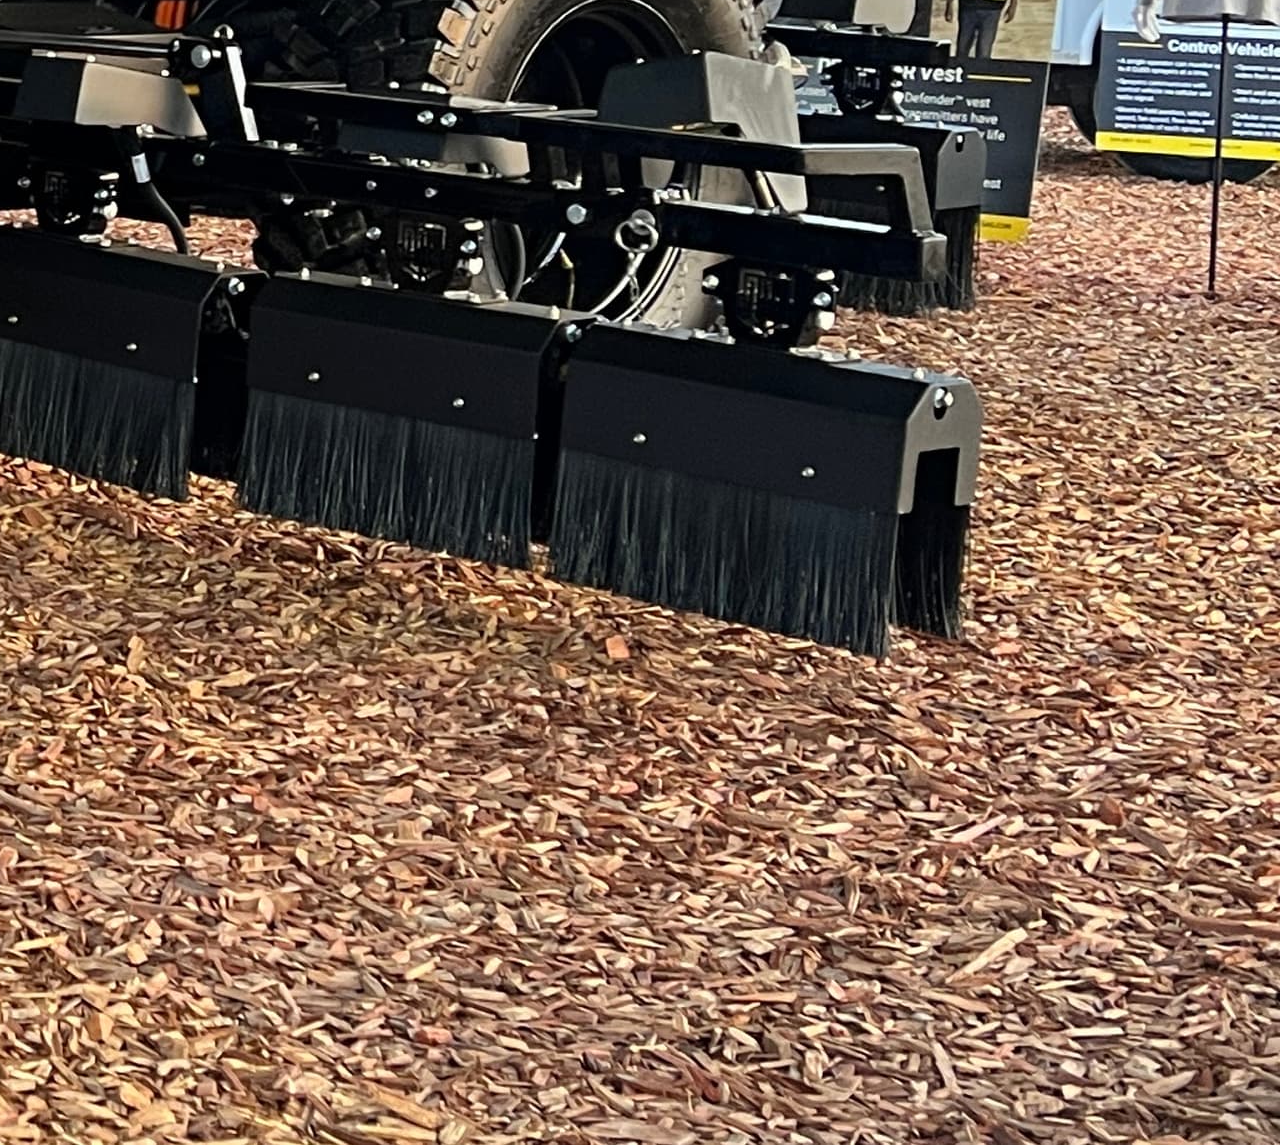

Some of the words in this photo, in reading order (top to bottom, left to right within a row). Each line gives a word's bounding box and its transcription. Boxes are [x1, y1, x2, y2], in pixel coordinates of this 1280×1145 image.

[1167, 38, 1222, 55] Control
[920, 66, 964, 84] vest
[965, 97, 991, 109] vest
[970, 112, 999, 125] have
